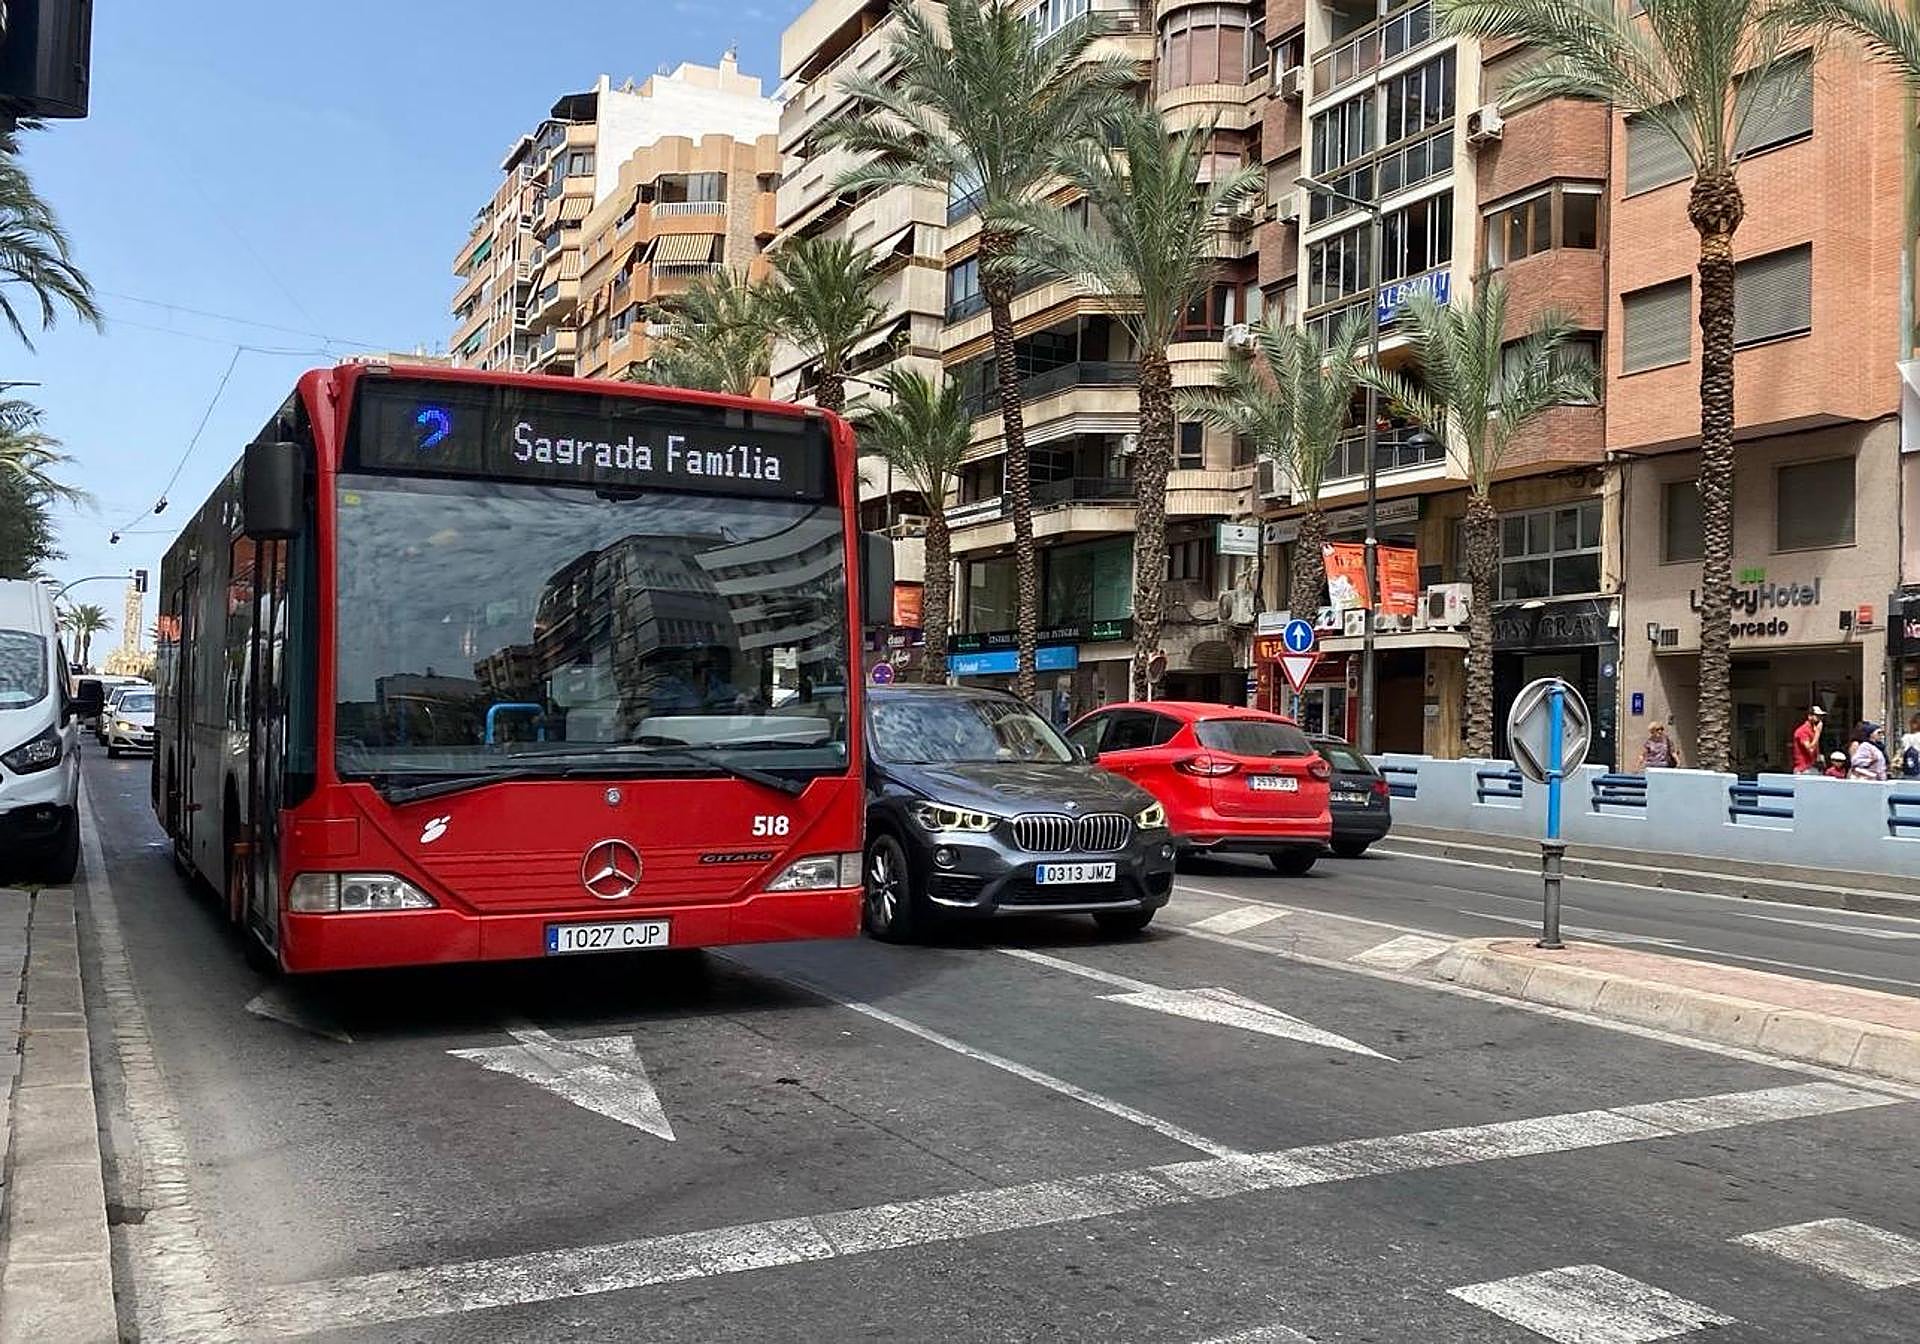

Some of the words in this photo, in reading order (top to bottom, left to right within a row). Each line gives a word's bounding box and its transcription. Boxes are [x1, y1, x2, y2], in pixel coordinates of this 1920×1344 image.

[513, 421, 653, 471] Sagrada
[667, 434, 782, 481] Família
[1728, 616, 1789, 638] ercado
[752, 815, 790, 836] 518
[1048, 866, 1083, 881] 0313
[1088, 865, 1112, 880] JMZ
[566, 927, 615, 949] 1027
[623, 925, 660, 945] CJP
